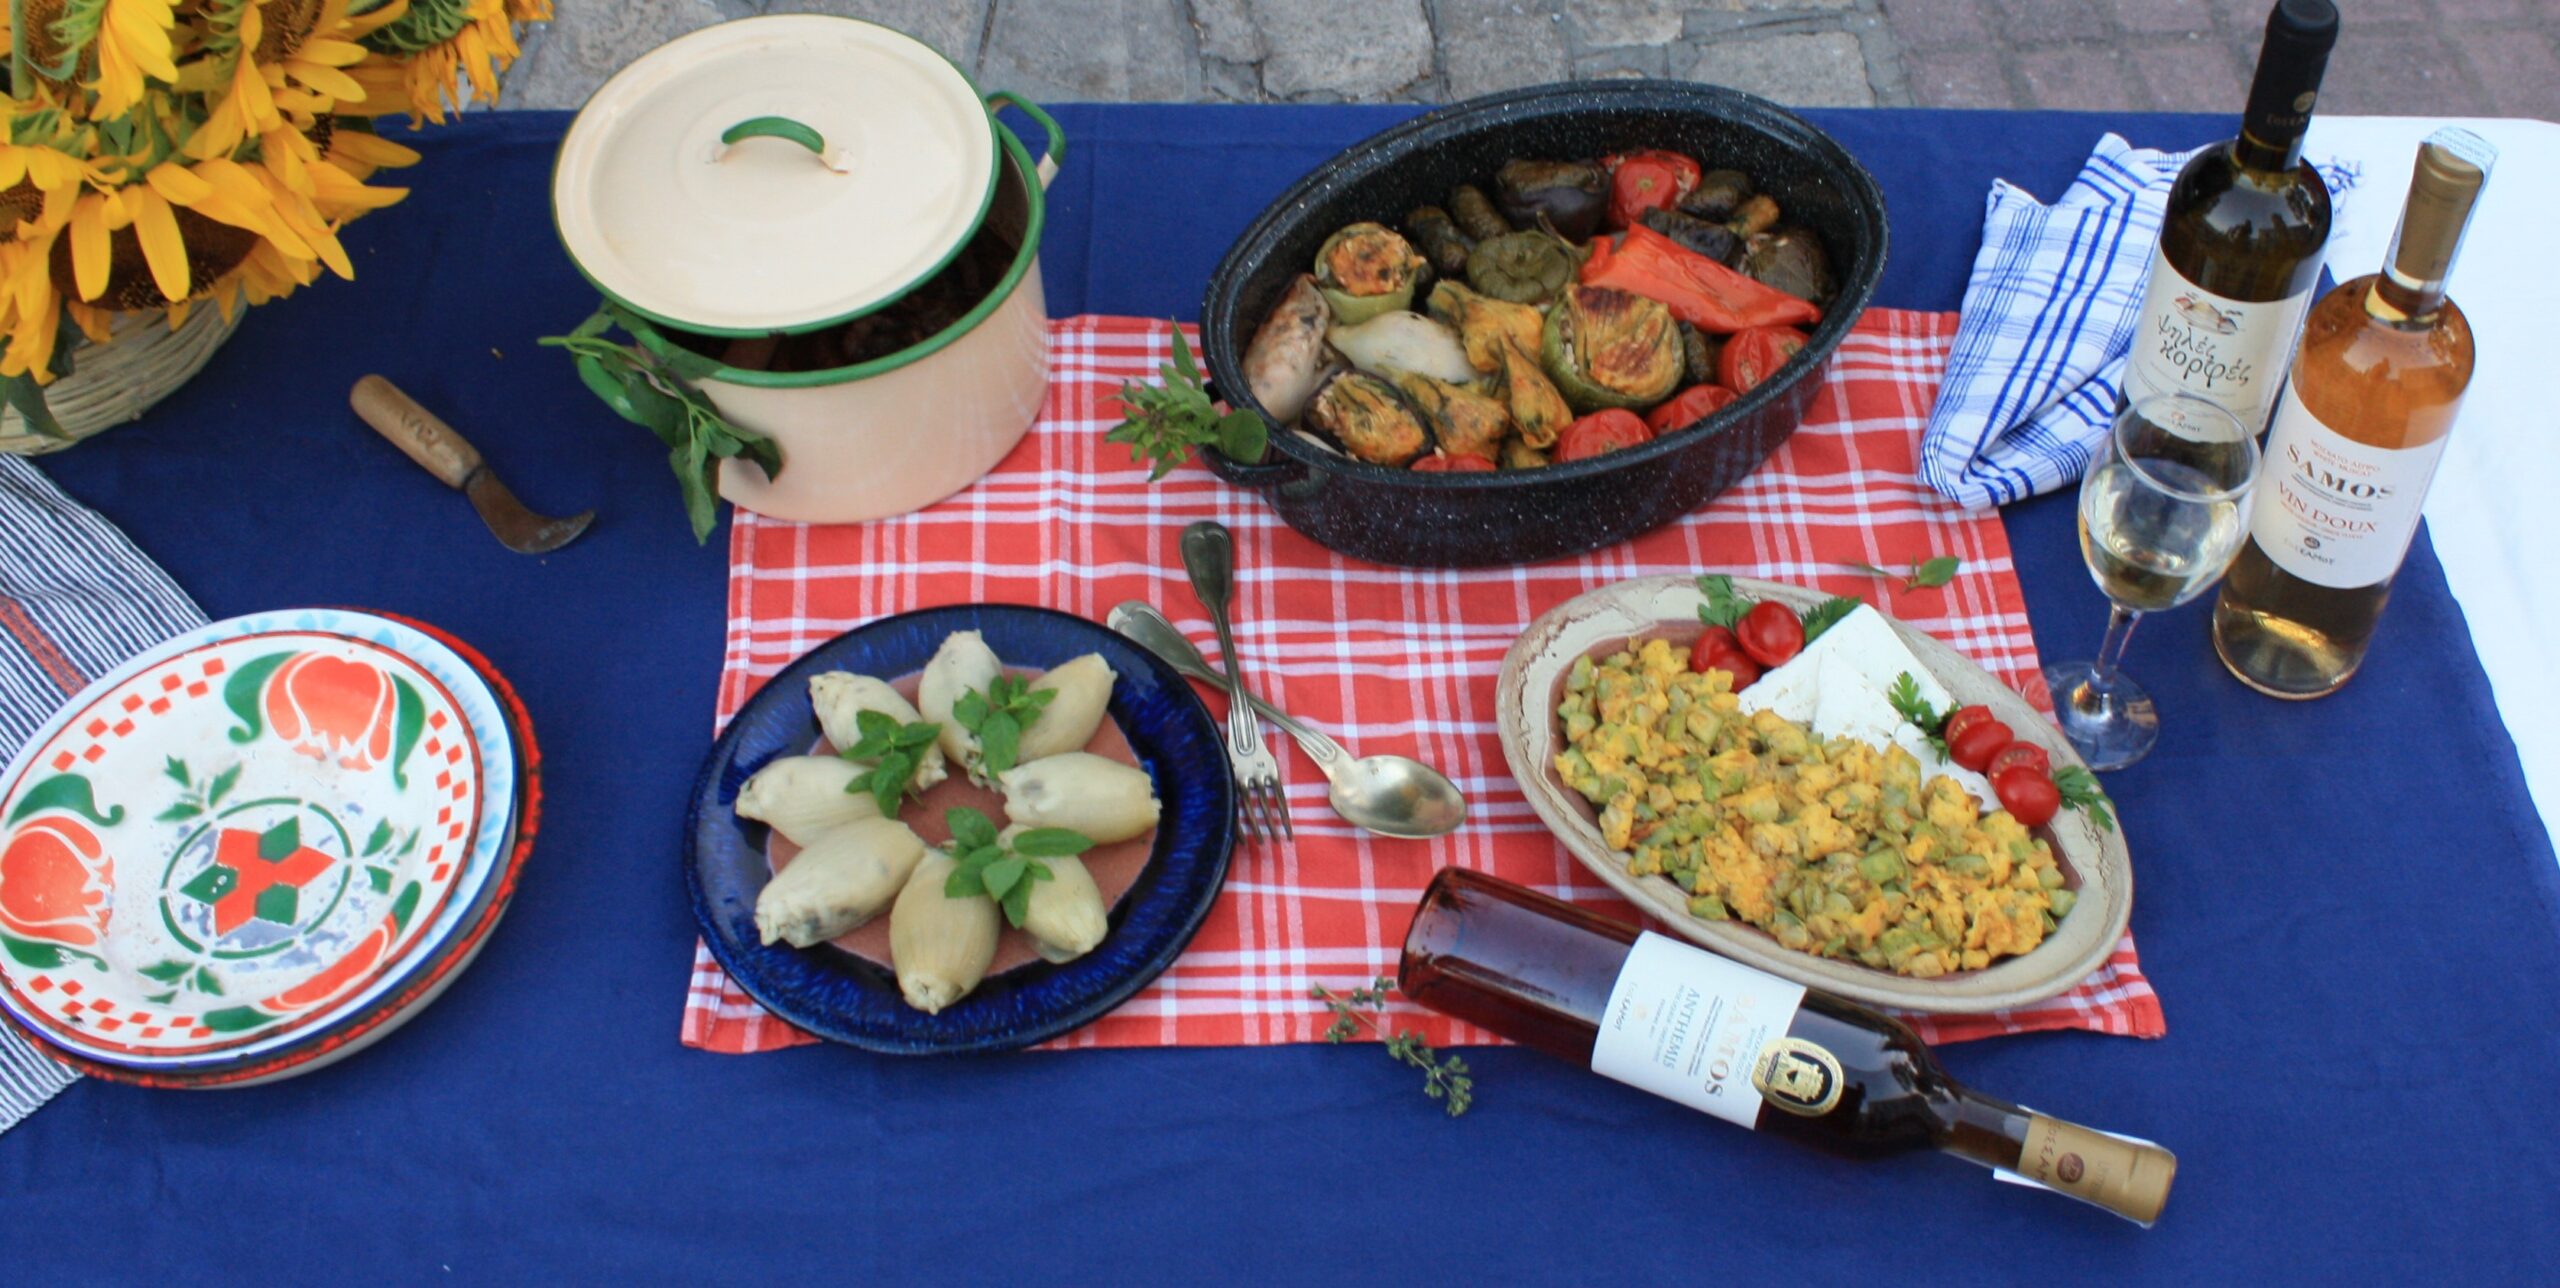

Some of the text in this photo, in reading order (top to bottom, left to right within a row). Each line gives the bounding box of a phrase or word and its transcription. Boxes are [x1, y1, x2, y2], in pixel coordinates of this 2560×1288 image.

[2287, 444, 2395, 500] SAMOS
[2279, 480, 2307, 513] VIN
[2312, 509, 2378, 533] DOUX
[1663, 988, 1700, 1069] ANTHEMIS
[1705, 993, 1756, 1097] SAMOS
